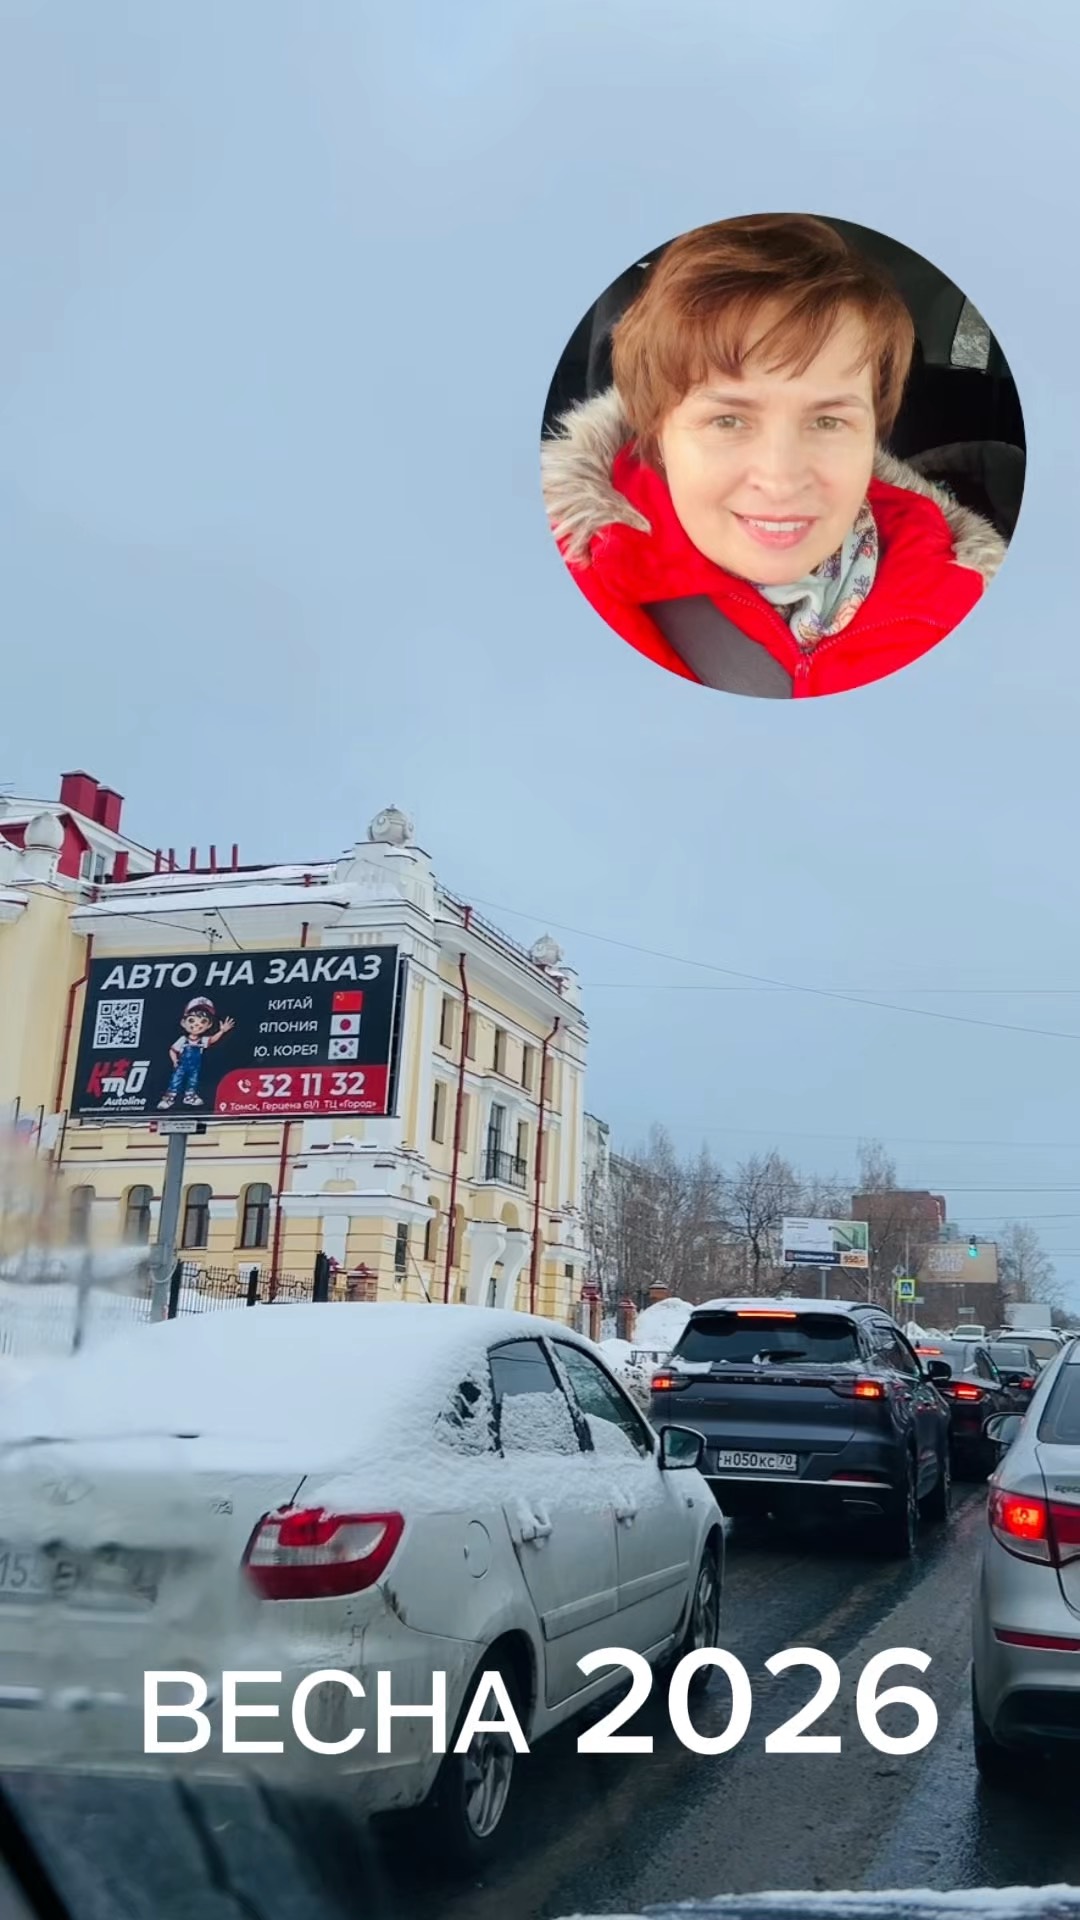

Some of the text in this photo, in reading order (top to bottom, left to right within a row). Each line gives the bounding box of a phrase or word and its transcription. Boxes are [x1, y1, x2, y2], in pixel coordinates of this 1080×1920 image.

[101, 954, 382, 990] АВТО НА ЗАКАЗ
[268, 995, 313, 1010] КИТАЙ
[259, 1020, 319, 1033] ЯПОНИЯ
[253, 1044, 319, 1057] Ю. КОРЕЯ
[256, 1071, 366, 1098] 32 11 32
[103, 1095, 147, 1107] Autoline
[229, 1102, 260, 1112] Томск,
[262, 1101, 302, 1112] Герцена
[323, 1100, 338, 1110] ТЦ
[338, 1099, 377, 1110] «Город»
